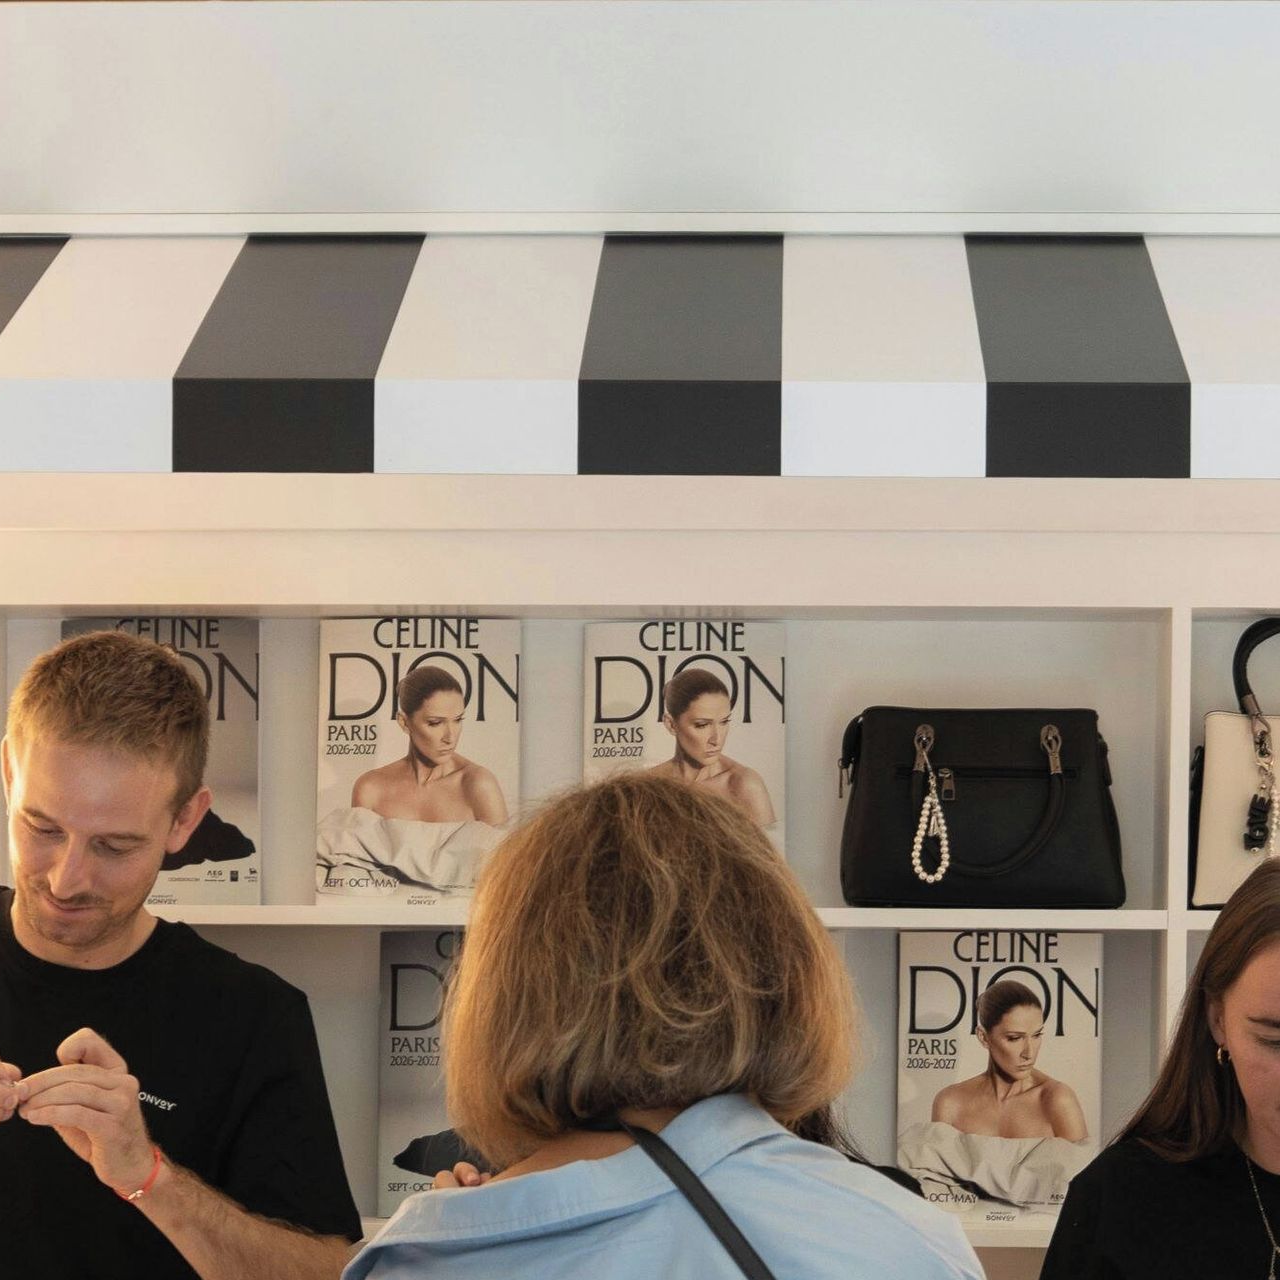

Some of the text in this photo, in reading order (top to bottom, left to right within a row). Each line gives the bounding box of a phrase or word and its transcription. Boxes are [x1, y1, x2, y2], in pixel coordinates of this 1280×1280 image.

[328, 651, 520, 722] DION
[594, 653, 786, 724] DION
[327, 724, 378, 742] PARIS
[593, 726, 645, 745] PARIS
[326, 743, 377, 756] 2026-2027
[592, 745, 644, 758] 2026-2027
[907, 965, 1100, 1038] DION
[391, 1036, 440, 1053] PARIS
[907, 1038, 957, 1056] PARIS
[906, 1057, 957, 1070] 2026-2027
[137, 1091, 177, 1111] ONVOY
[387, 1182, 409, 1192] SEPT
